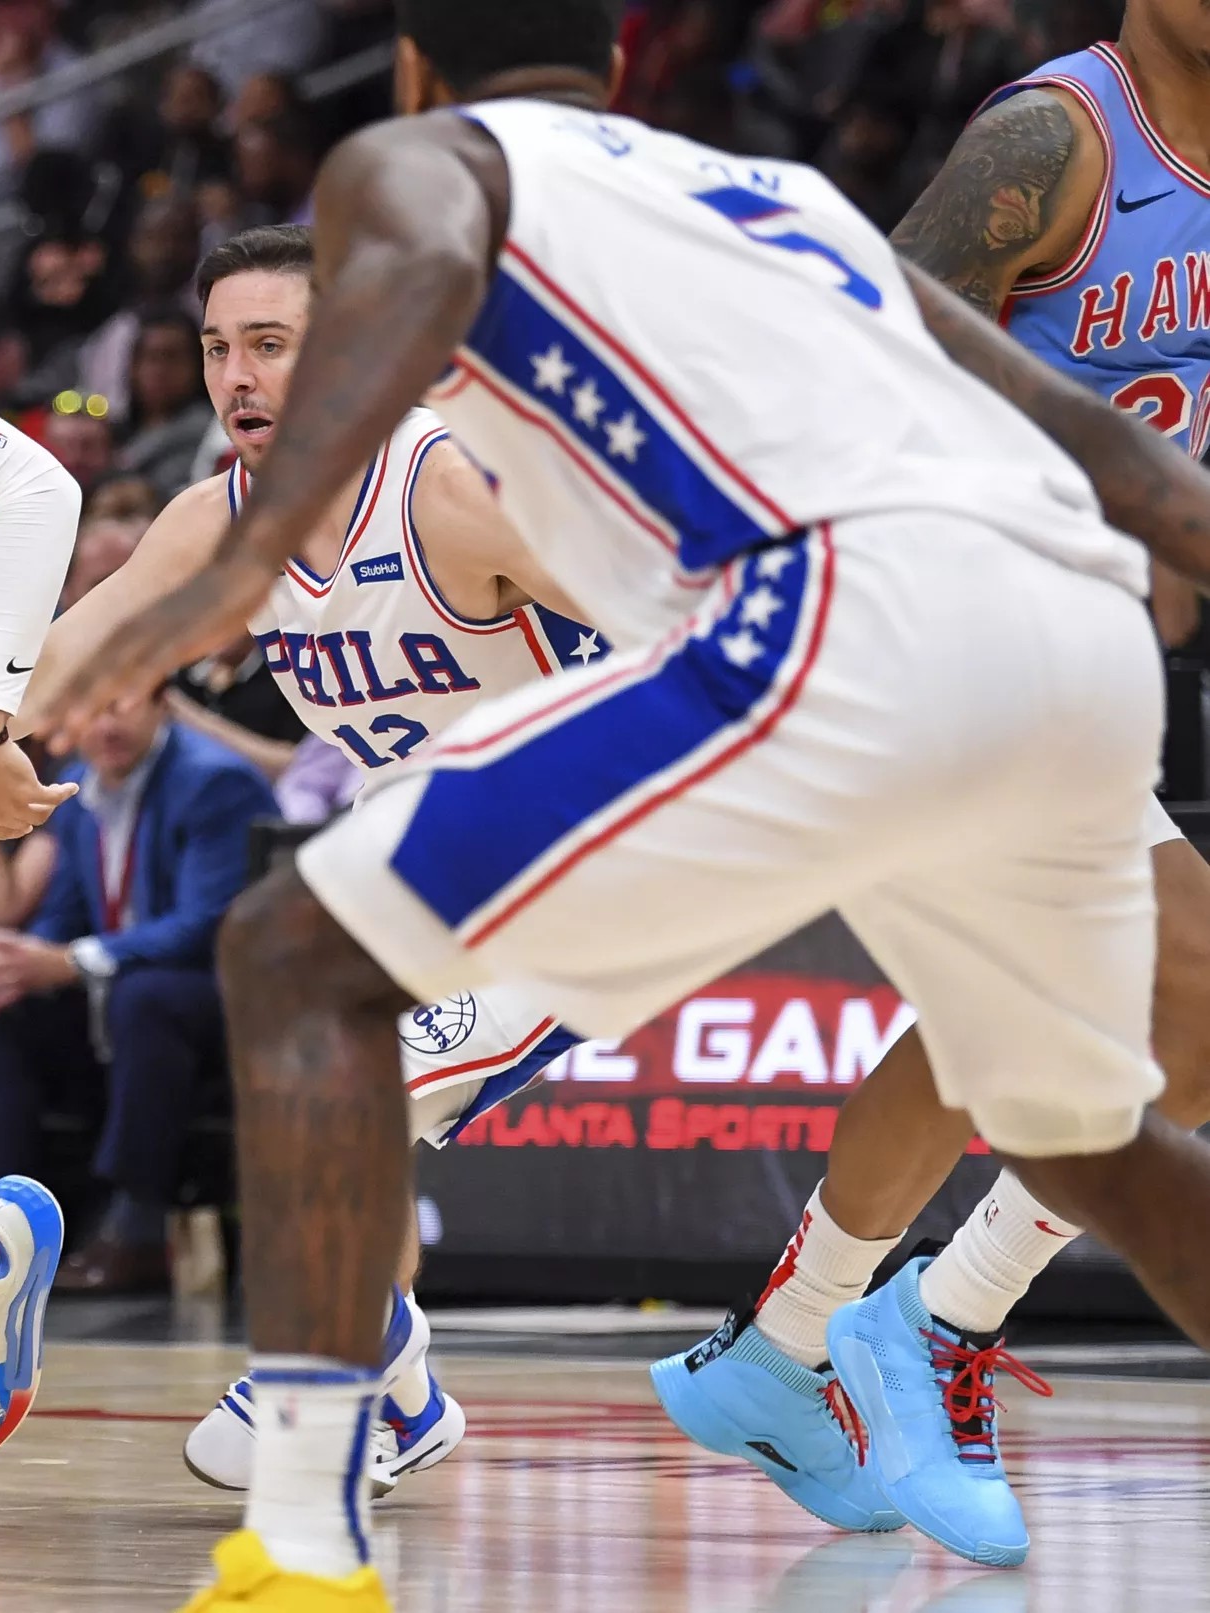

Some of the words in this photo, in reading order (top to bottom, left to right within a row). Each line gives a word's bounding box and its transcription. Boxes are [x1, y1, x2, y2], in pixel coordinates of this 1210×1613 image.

[359, 561, 399, 578] StubHub
[253, 629, 482, 707] PHILA
[331, 714, 430, 769] 12
[413, 1004, 451, 1049] 6ers
[674, 998, 920, 1083] GAM
